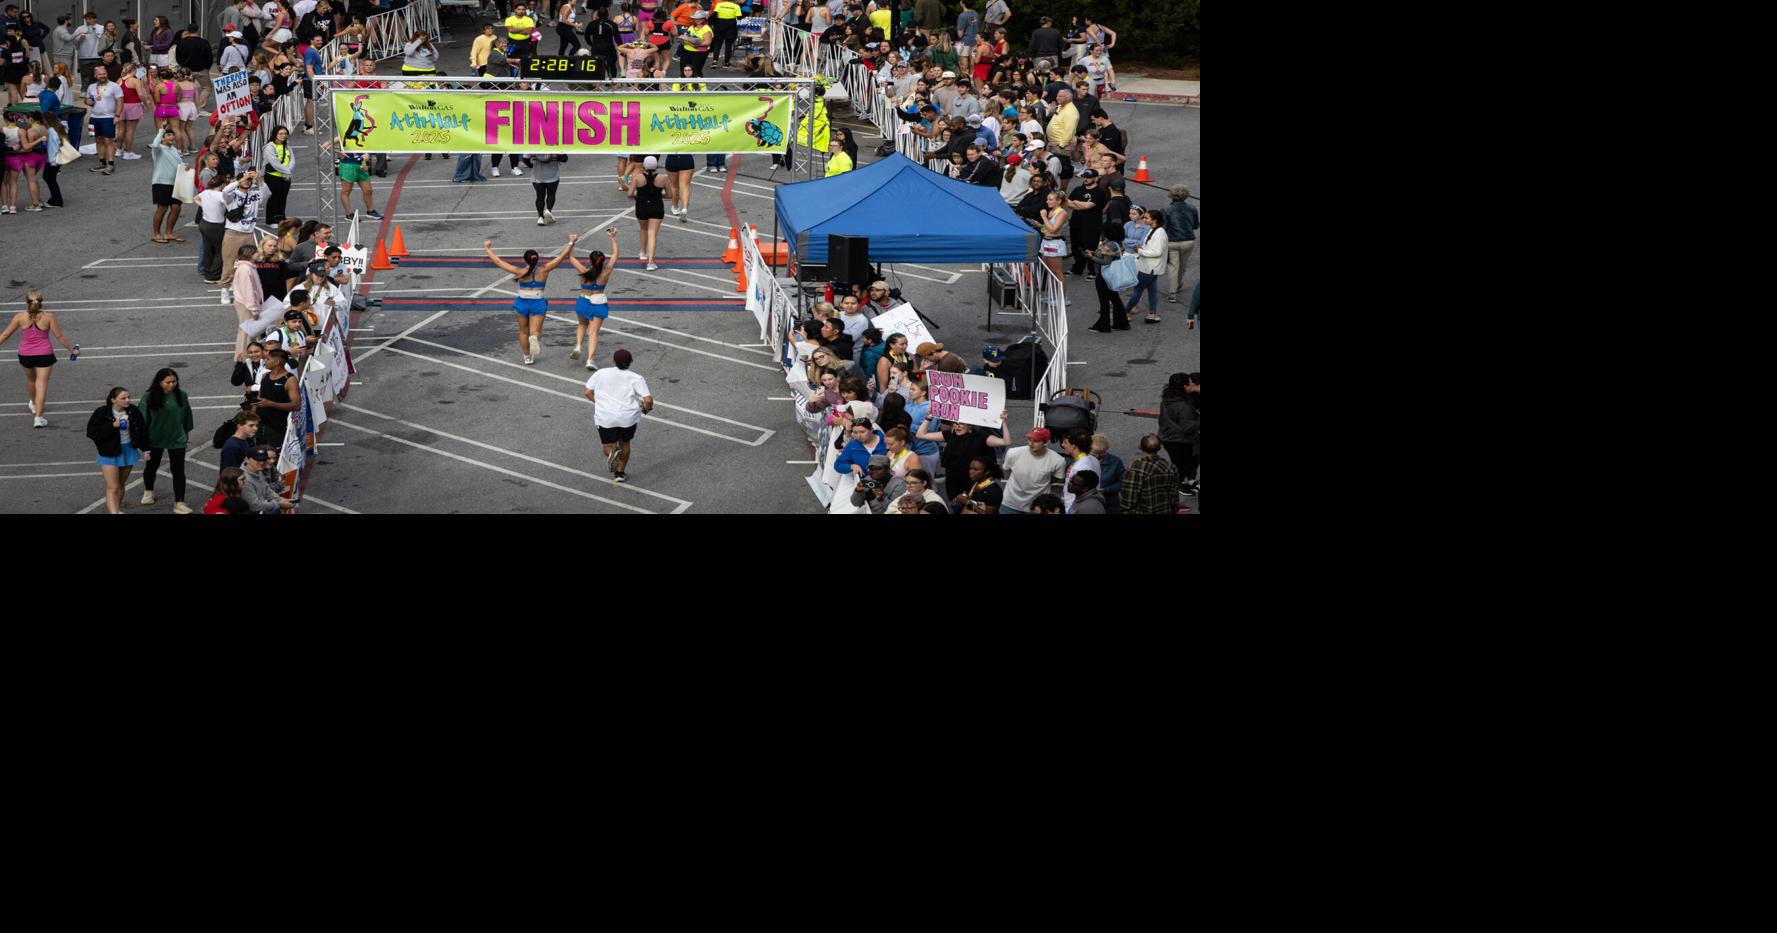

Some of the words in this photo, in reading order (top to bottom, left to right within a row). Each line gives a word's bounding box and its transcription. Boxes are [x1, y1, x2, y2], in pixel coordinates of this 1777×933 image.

[215, 71, 247, 87] THERAPY
[216, 85, 231, 95] WAS
[233, 79, 247, 90] ALSO
[220, 95, 251, 114] OPTION
[485, 101, 641, 146] FINISH
[410, 130, 450, 144] 2025
[671, 131, 711, 145] 2025
[929, 371, 965, 389] RUN
[929, 385, 989, 409] POOKIE
[931, 400, 960, 421] RUN
